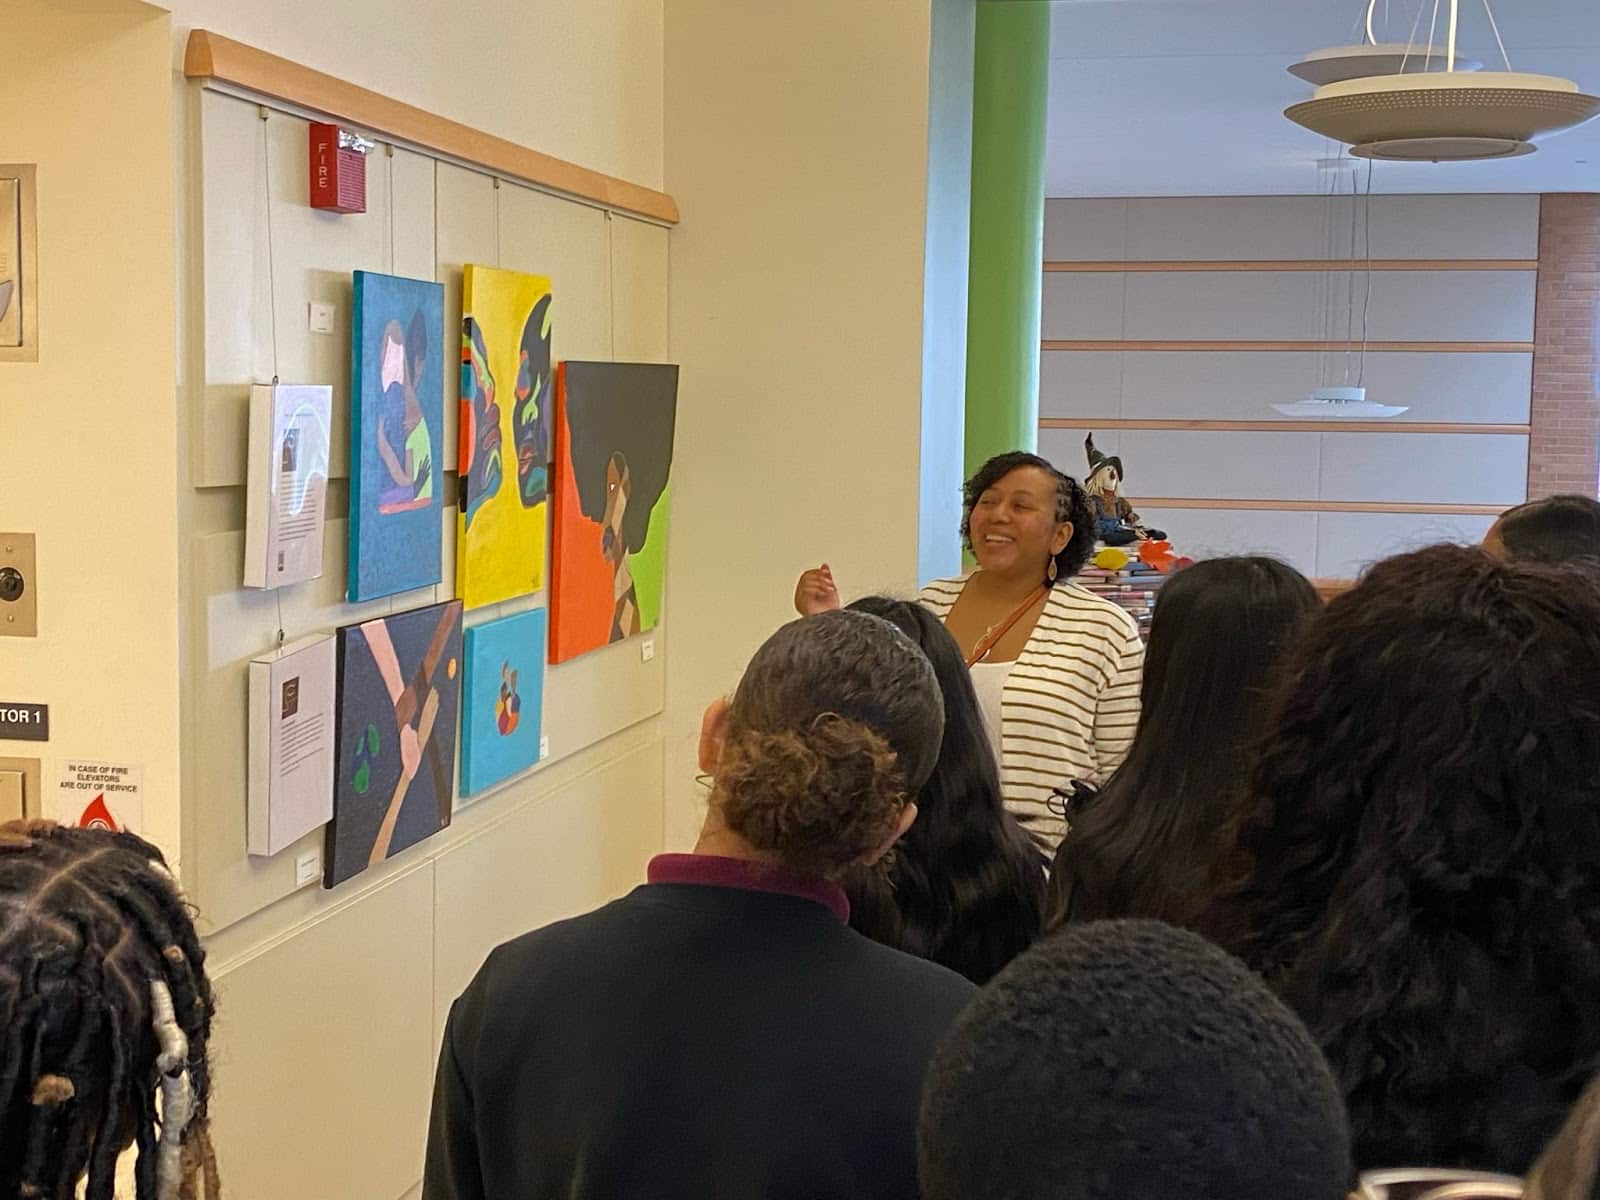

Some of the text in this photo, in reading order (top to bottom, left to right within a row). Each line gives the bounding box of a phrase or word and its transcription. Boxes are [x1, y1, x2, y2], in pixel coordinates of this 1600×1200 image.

[318, 142, 329, 188] FIRE
[33, 710, 41, 724] 1
[77, 765, 98, 773] CASE
[112, 767, 128, 775] FIRE
[77, 774, 120, 782] ELEVATORS
[60, 781, 75, 789] ARE
[76, 782, 92, 790] OUT
[105, 784, 138, 792] SERVICE
